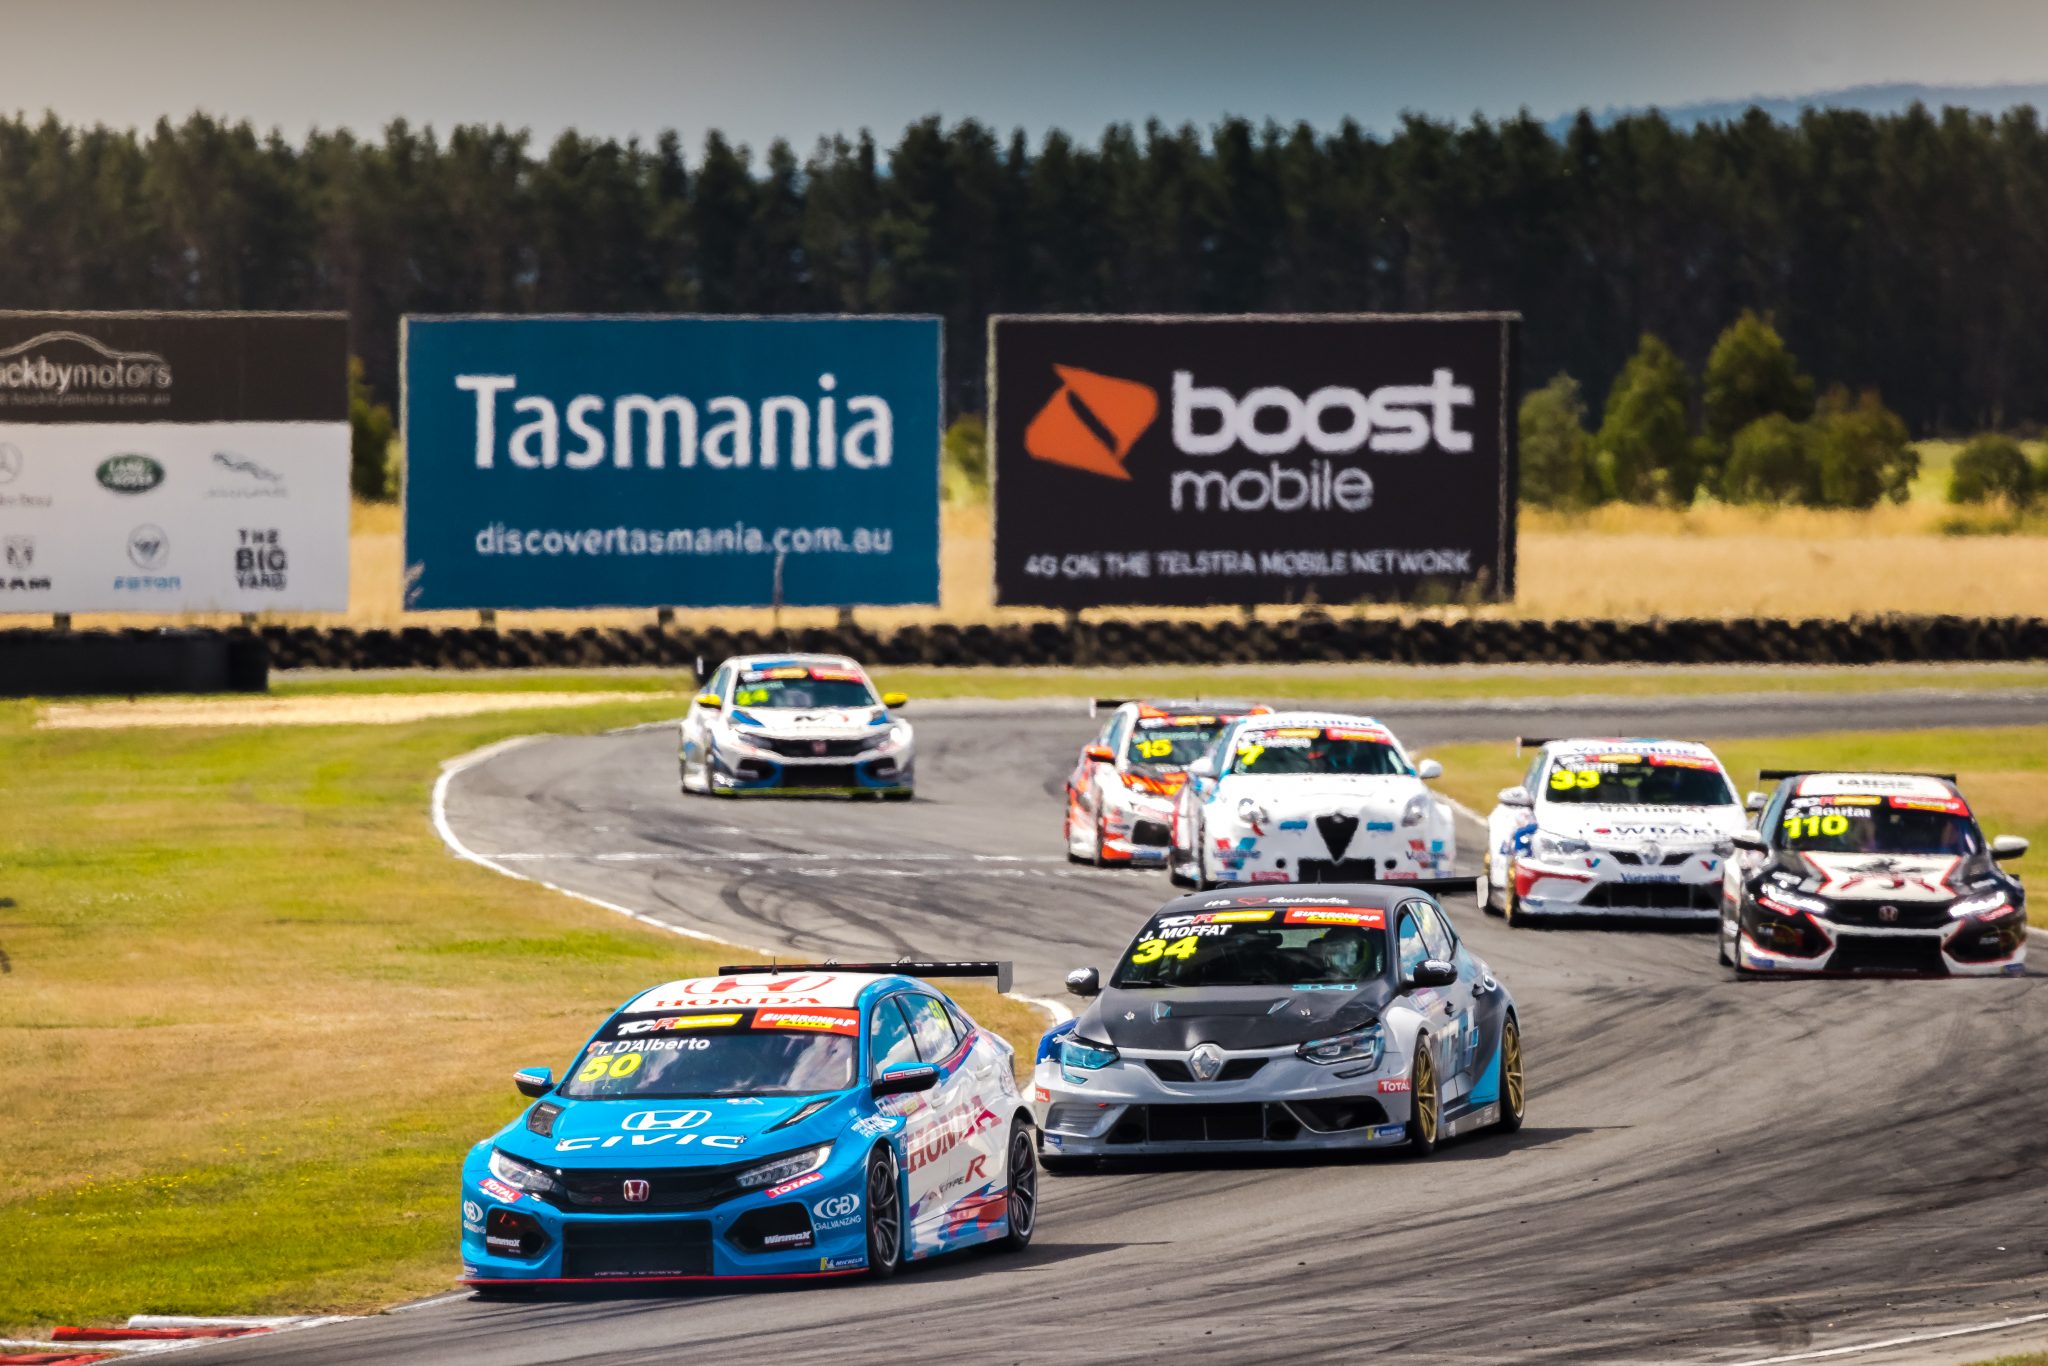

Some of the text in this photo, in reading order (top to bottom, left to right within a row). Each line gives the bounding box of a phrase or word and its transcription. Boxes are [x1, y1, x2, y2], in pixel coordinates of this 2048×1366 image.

[455, 372, 893, 469] Tasmania
[1171, 367, 1474, 455] boost
[1171, 459, 1374, 512] mobile
[237, 529, 279, 545] THE
[475, 521, 893, 556] discovertasmania.com.au
[235, 547, 288, 572] BIG
[1025, 549, 1472, 577] 4G ON THE TELSTRA MOBILE NETWORK
[1136, 739, 1173, 759] 15
[1236, 745, 1265, 765] 7
[1550, 769, 1600, 791] 33
[1783, 815, 1849, 839] 110
[1139, 924, 1233, 943] J. MOFFAT
[1132, 936, 1200, 965] 34
[655, 996, 822, 1008] HONDA
[617, 1017, 680, 1036] TCR
[760, 1013, 857, 1027] SUPERCHEAP
[598, 1037, 711, 1056] T. D'Alberto
[578, 1052, 642, 1083] 50
[1381, 1081, 1411, 1093] TOTAL
[555, 1134, 747, 1152] CIVIC
[484, 1179, 515, 1201] TOTAL
[769, 1173, 821, 1196] TOTAL
[826, 1196, 851, 1217] GB
[814, 1214, 862, 1231] GALVANIZING
